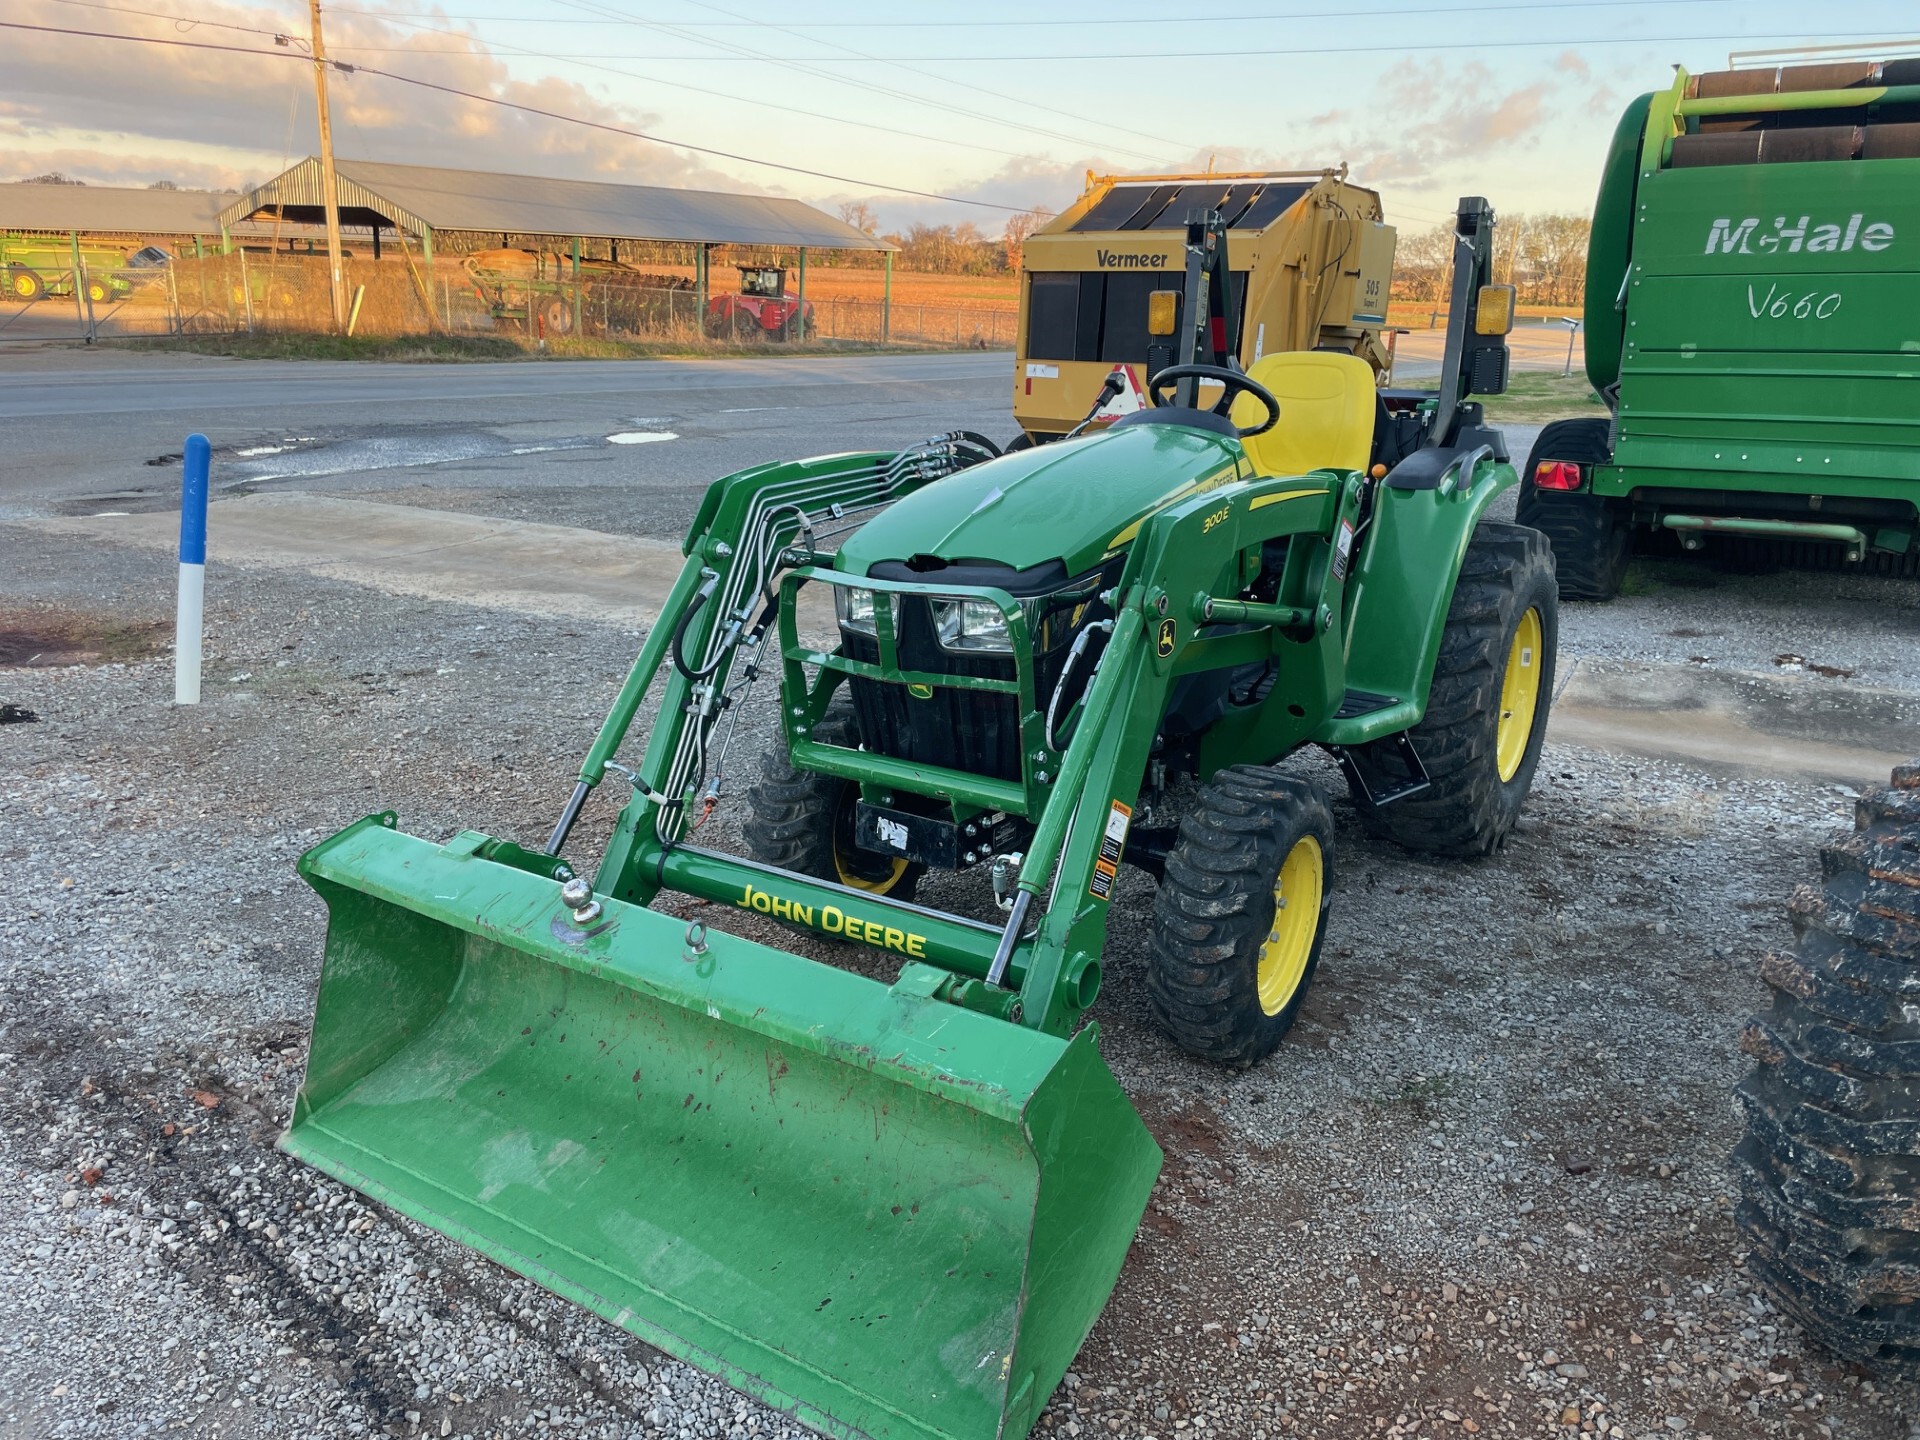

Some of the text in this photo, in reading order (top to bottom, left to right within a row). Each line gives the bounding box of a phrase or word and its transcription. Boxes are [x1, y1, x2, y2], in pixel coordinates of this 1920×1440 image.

[1705, 213, 1894, 254] McHale
[1097, 249, 1168, 268] Vermeer
[1366, 279, 1381, 296] 505
[1748, 282, 1842, 320] V660
[1202, 505, 1230, 534] 300E
[736, 884, 927, 959] JOHN DEERE
